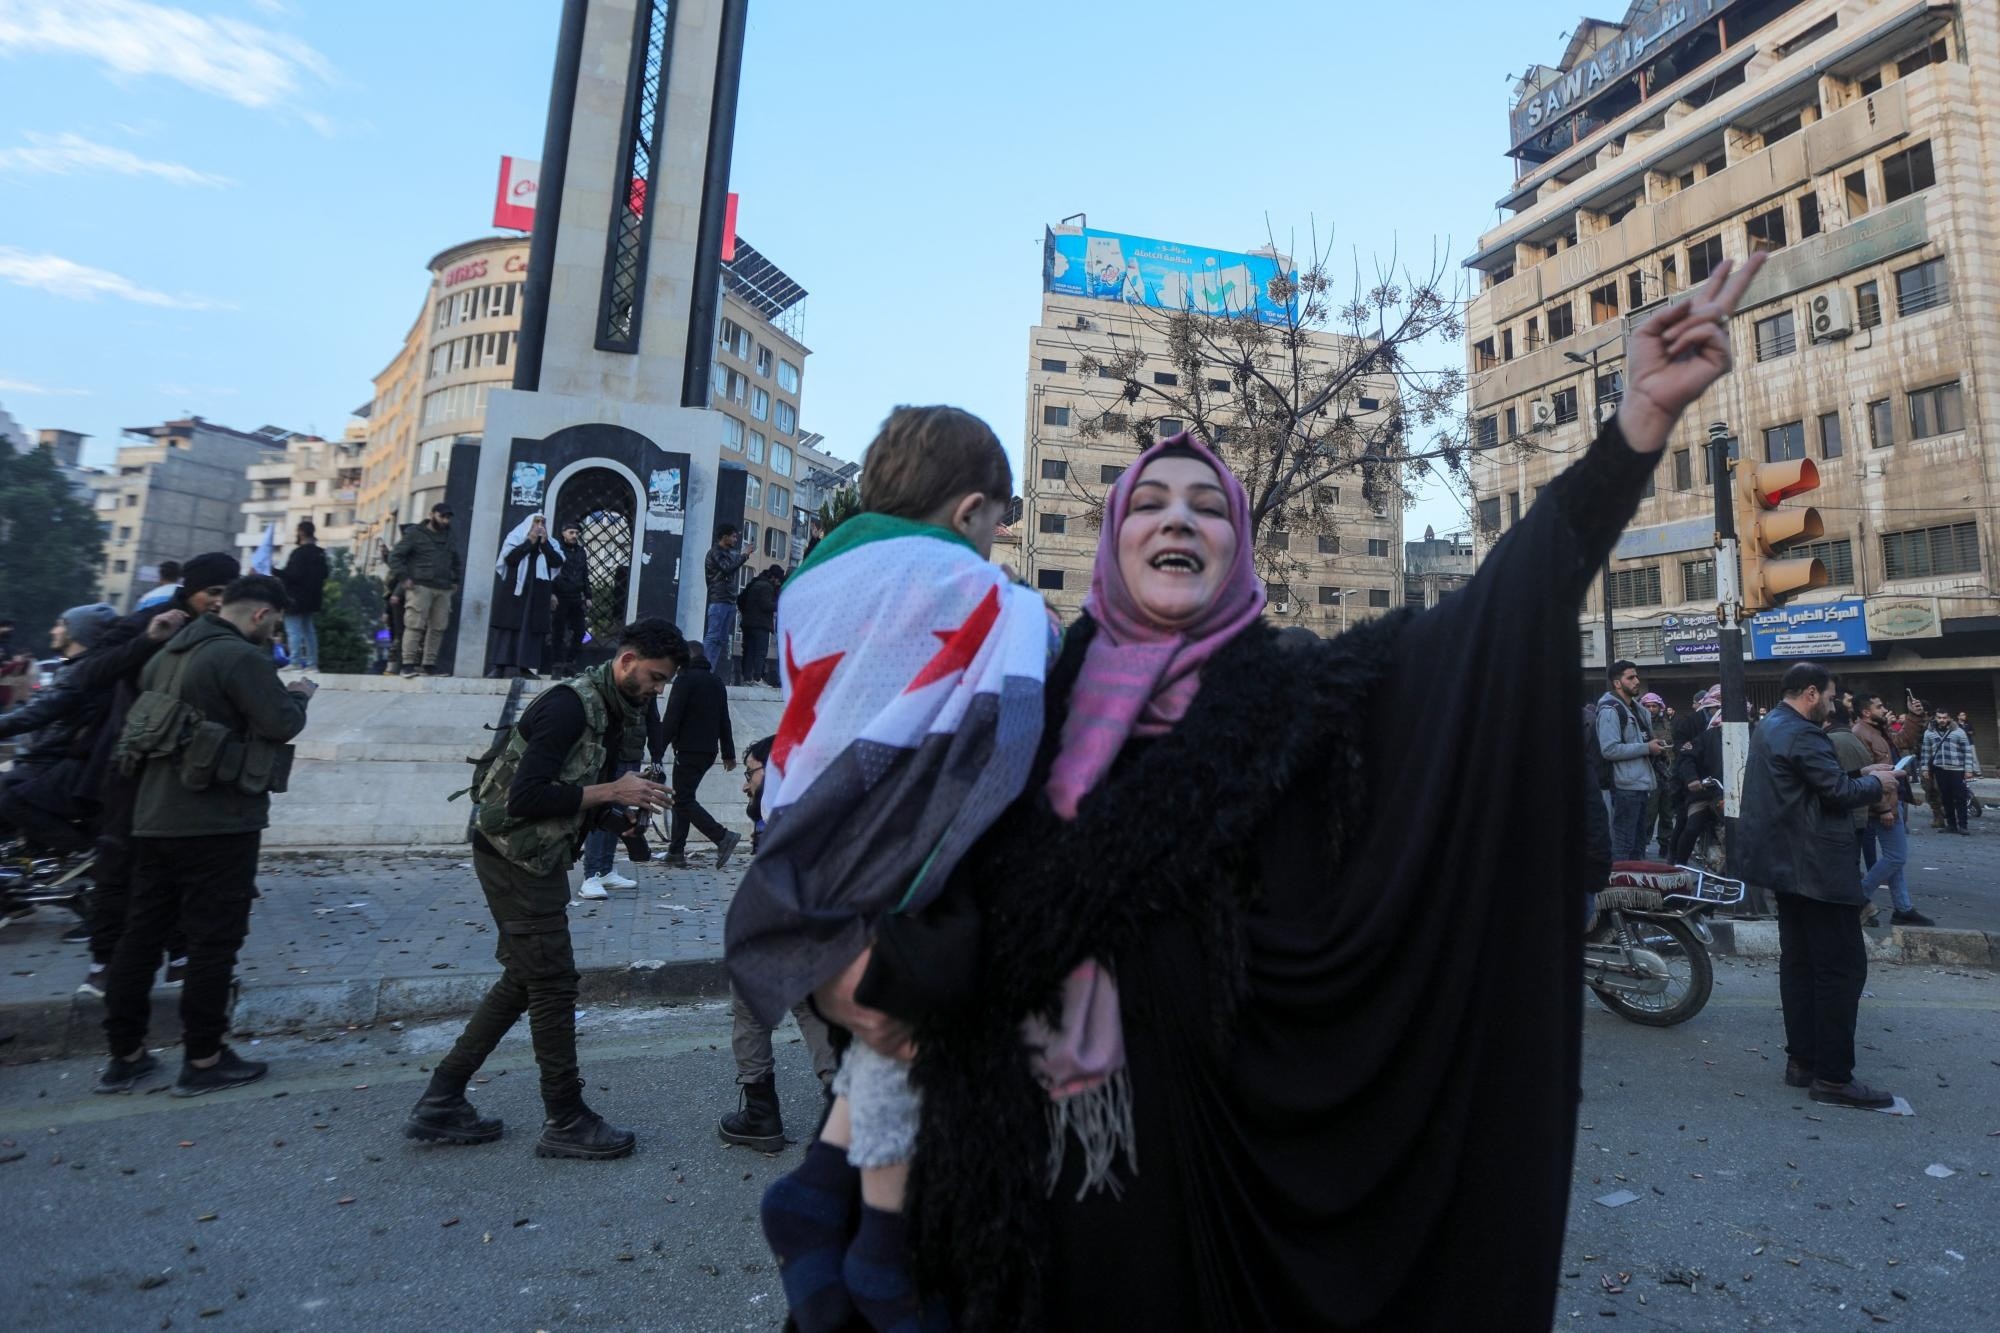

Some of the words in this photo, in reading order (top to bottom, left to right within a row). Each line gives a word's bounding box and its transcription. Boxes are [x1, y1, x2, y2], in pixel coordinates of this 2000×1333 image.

[1559, 240, 1603, 285] LORD
[1752, 612, 1788, 628] الحديث
[1788, 609, 1824, 629] الطبي
[1824, 606, 1859, 623] المركز
